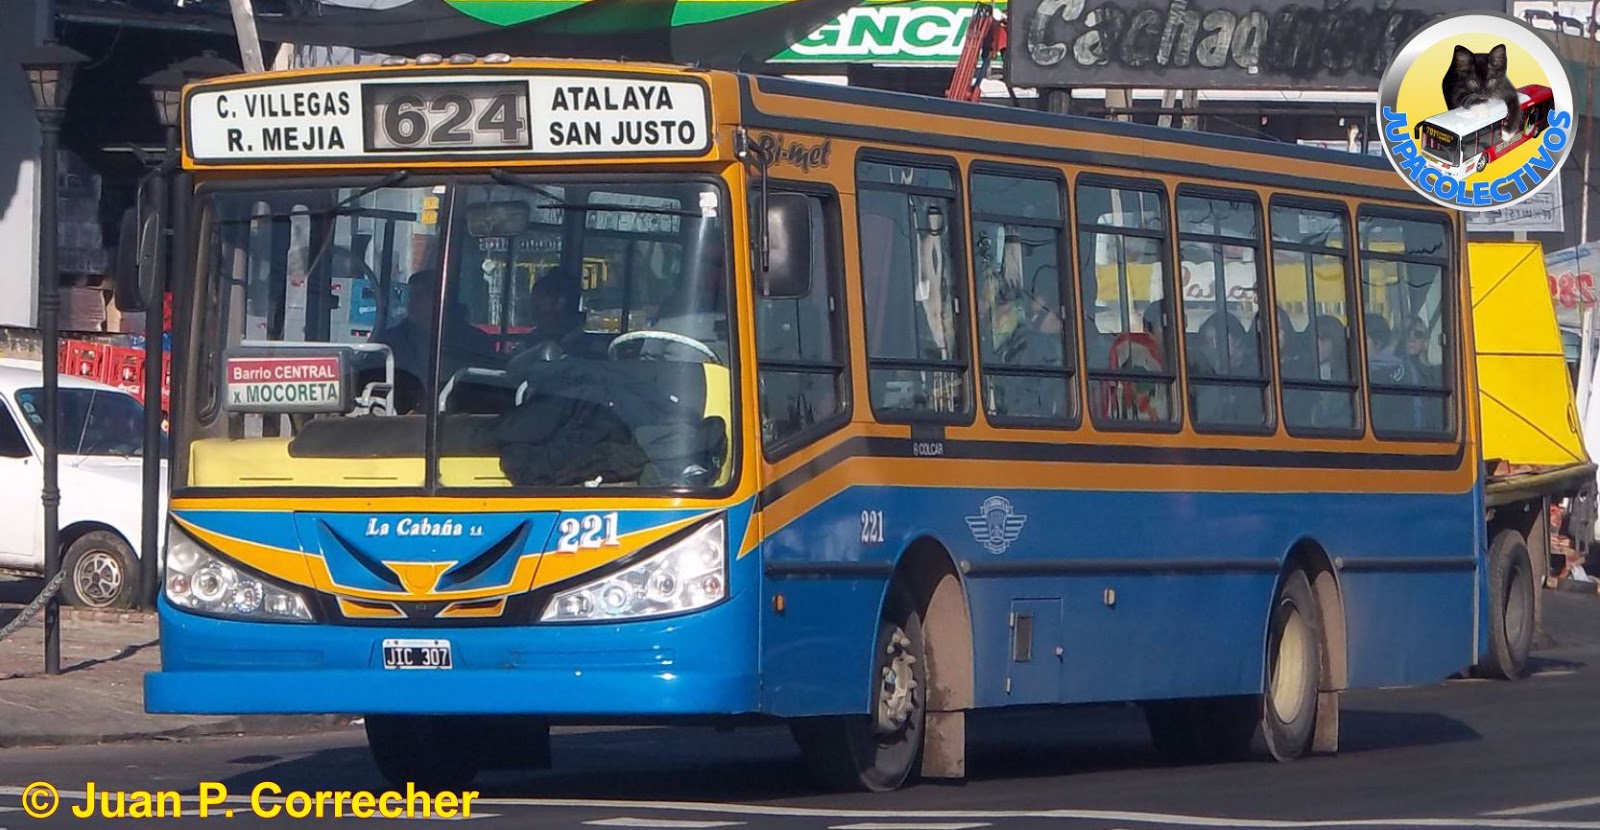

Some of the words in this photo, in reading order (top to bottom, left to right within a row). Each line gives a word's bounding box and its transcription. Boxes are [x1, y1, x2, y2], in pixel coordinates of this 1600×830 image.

[216, 94, 236, 119] C.
[244, 91, 350, 118] VILLEGAS
[551, 86, 674, 111] ATALAYA
[384, 92, 526, 150] 624
[549, 121, 601, 146] SAN
[610, 120, 696, 146] JUSTO
[227, 128, 252, 151] R.
[261, 126, 345, 151] MEJIA
[759, 132, 832, 174] Bi-met
[233, 366, 271, 380] Barrio
[274, 365, 336, 379] CENTRAL
[233, 390, 242, 404] x
[246, 383, 338, 403] MOCORETA
[365, 517, 390, 536] La
[396, 517, 463, 536] Cabaña
[557, 512, 620, 554] 221
[860, 509, 885, 543] 221
[387, 647, 414, 666] JIC
[421, 647, 448, 666] 307
